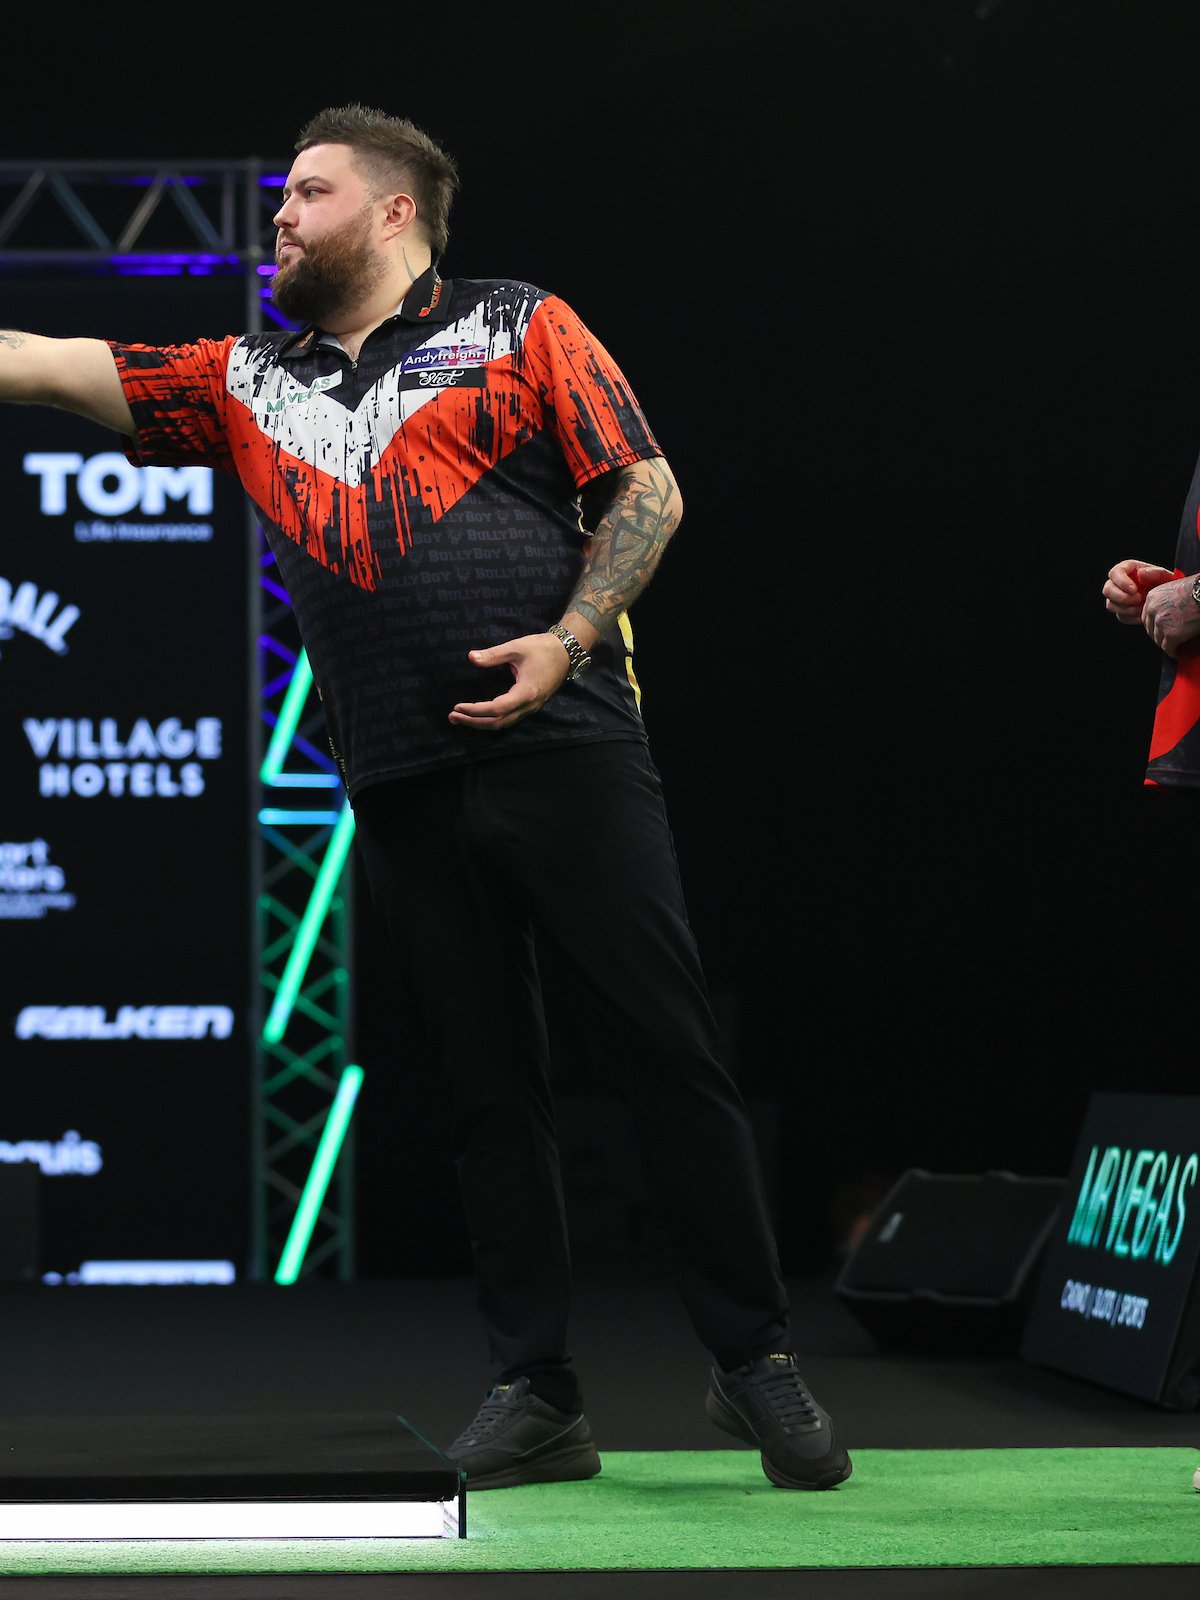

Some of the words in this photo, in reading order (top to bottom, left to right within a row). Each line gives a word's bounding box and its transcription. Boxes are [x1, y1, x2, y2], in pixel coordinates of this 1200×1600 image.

[404, 349, 482, 366] Andyfreight
[419, 370, 465, 388] Shot
[23, 452, 214, 516] TOM
[23, 717, 222, 759] VILLAGE
[39, 762, 205, 798] HOTELS
[1066, 1145, 1120, 1247] MR
[1105, 1149, 1199, 1267] VEGAS
